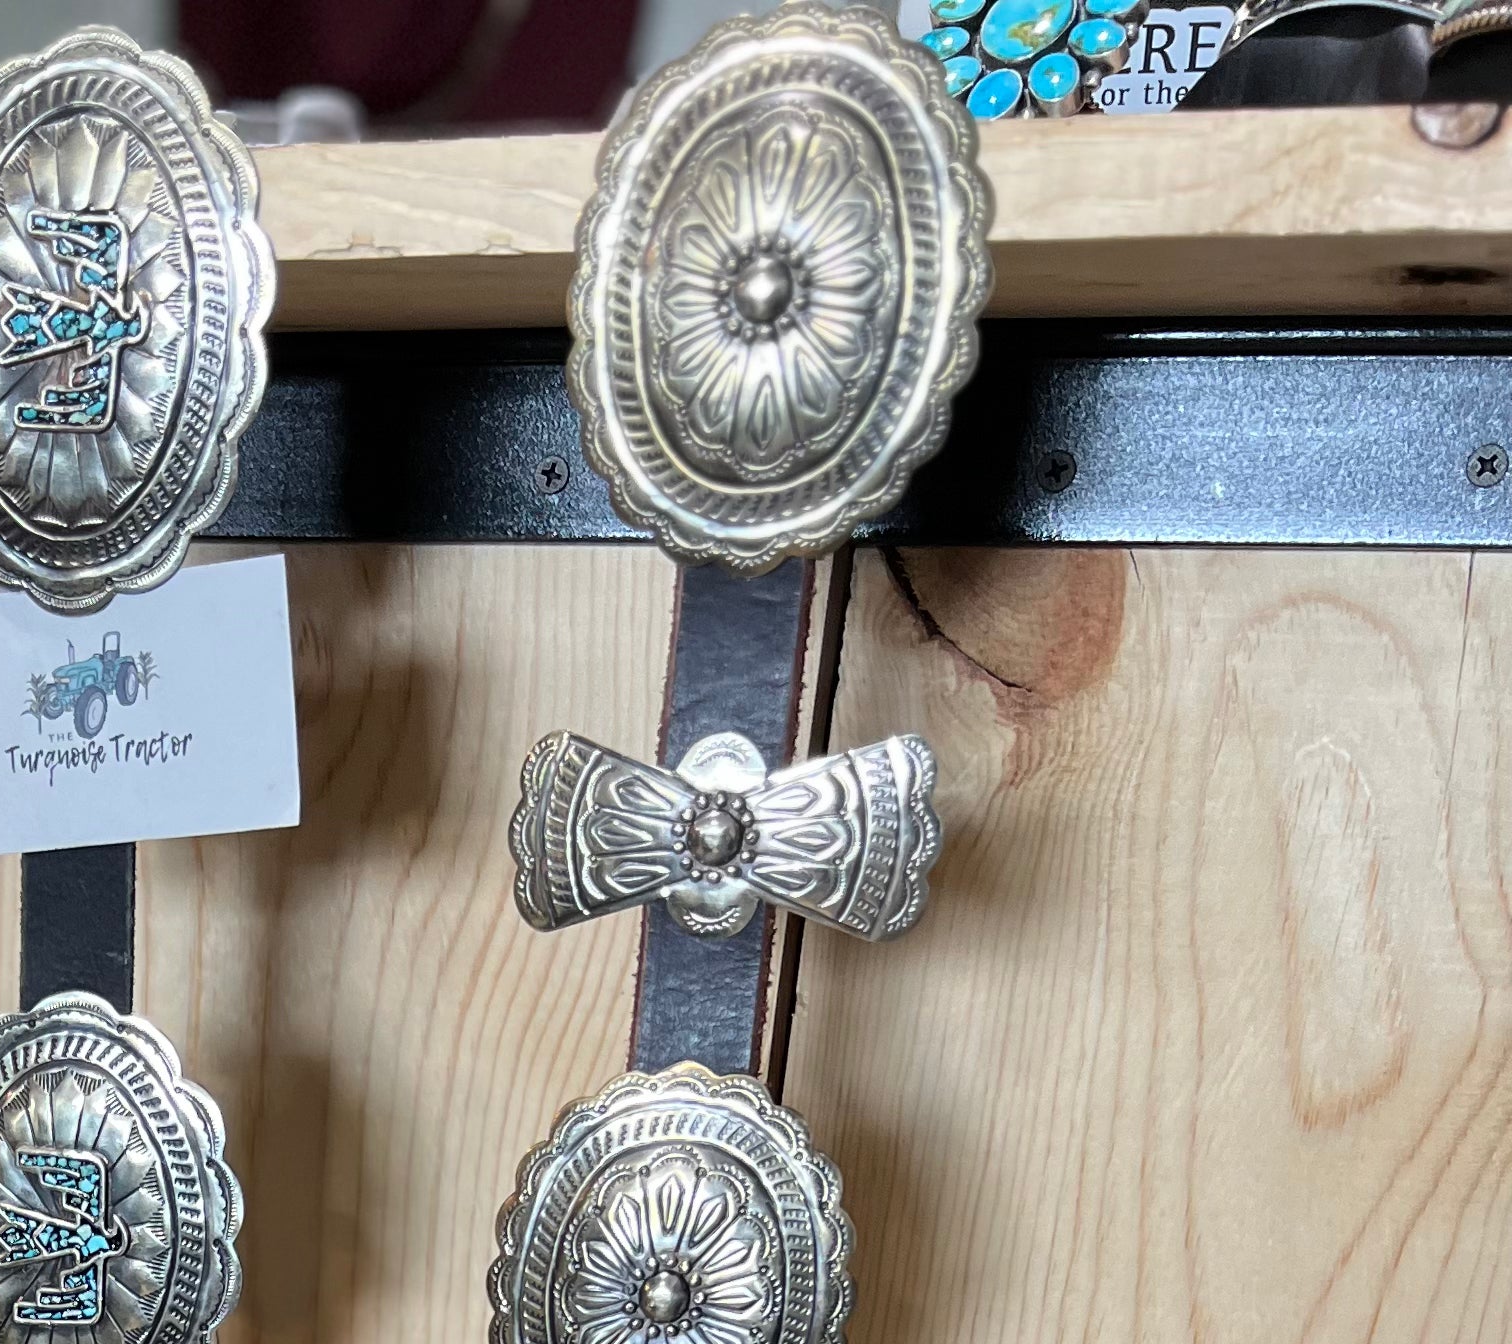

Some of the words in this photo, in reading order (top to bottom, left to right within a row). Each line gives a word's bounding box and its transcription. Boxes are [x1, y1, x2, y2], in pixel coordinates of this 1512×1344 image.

[1116, 21, 1222, 74] RE
[1094, 86, 1130, 106] or
[1143, 79, 1189, 105] the
[48, 732, 73, 743] THE
[4, 740, 107, 787] Turquoise
[109, 730, 193, 766] Tractor
